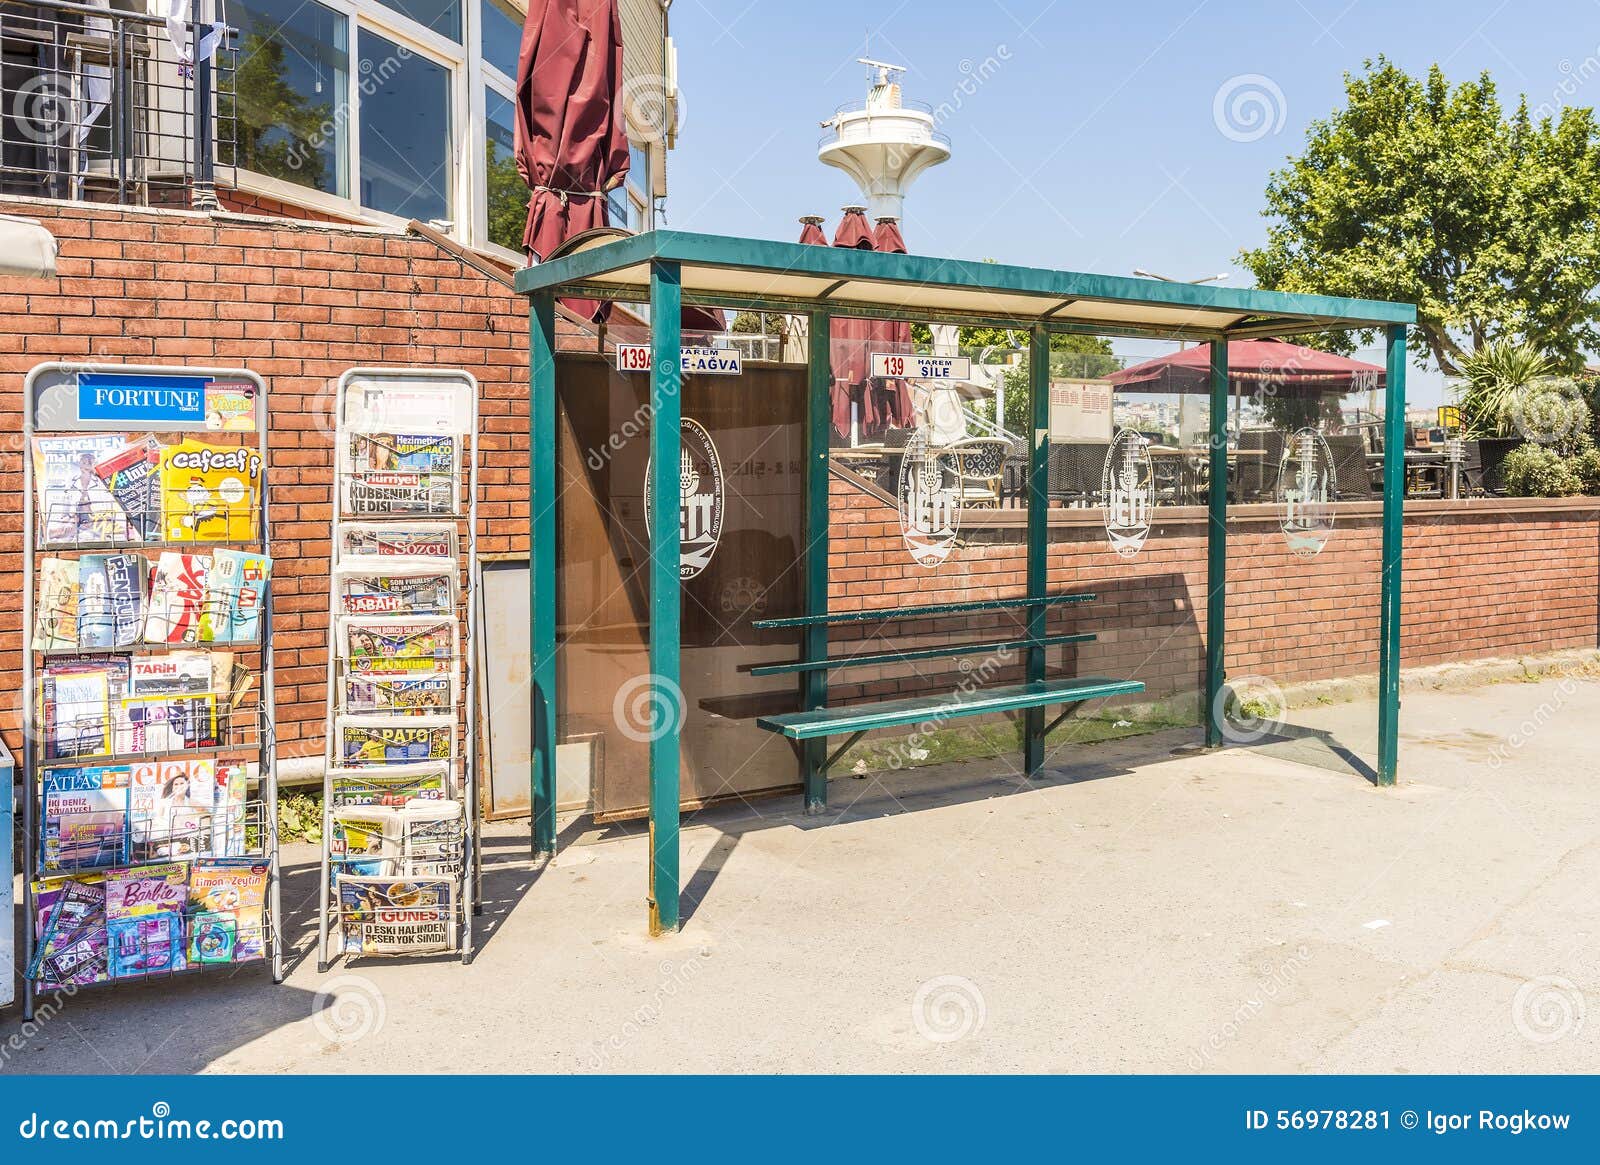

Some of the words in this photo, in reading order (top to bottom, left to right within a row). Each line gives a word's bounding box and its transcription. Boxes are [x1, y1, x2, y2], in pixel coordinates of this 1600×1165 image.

[681, 356, 739, 371] E-AĞVA
[884, 357, 904, 376] 139
[917, 359, 952, 367] HAREM
[95, 388, 200, 408] FORTUNE
[172, 449, 249, 474] cafcaf
[108, 557, 136, 643] PENGUEN
[134, 662, 177, 680] TARİH
[382, 728, 429, 743] PATO
[47, 774, 101, 792] ATLAS
[195, 877, 224, 887] Limon
[231, 876, 261, 888] Zeytin
[121, 881, 178, 907] Barbie
[396, 934, 415, 944] YOK
